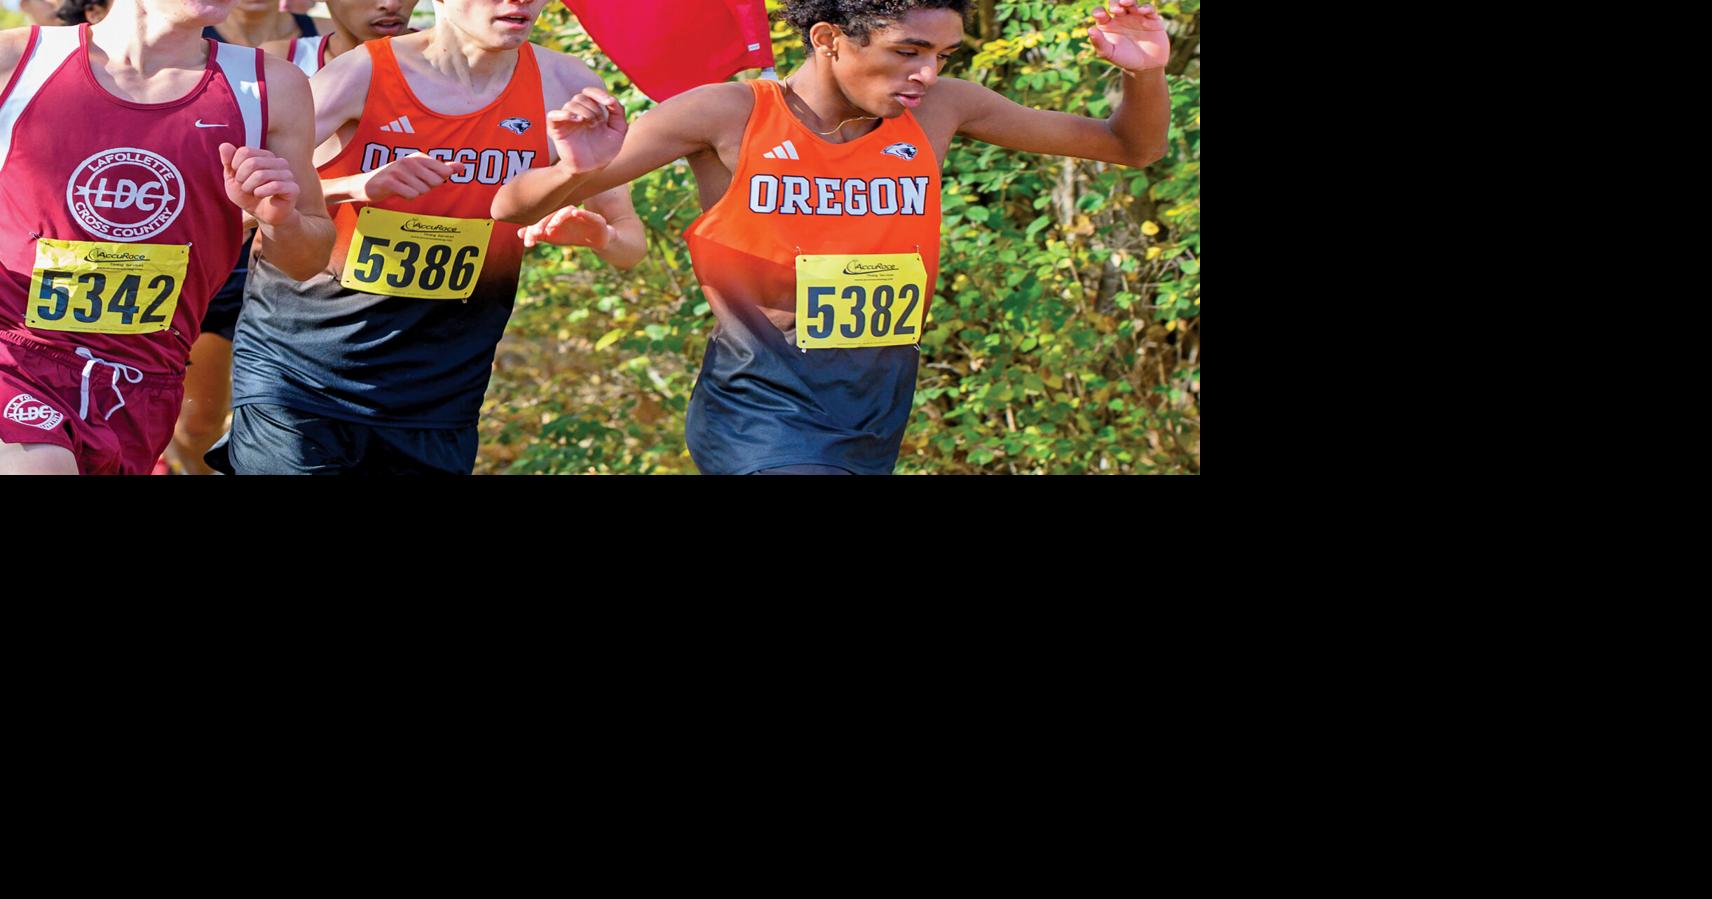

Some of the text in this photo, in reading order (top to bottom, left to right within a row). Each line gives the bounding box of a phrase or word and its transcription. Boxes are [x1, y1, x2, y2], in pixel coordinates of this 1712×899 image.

[87, 152, 175, 182] LAFOLLETTE
[94, 177, 162, 212] LDC
[749, 174, 930, 216] OREGON
[75, 201, 173, 238] CROSS COUNTRY
[353, 235, 480, 292] 5386
[37, 269, 175, 325] 5342
[806, 283, 920, 339] 5382
